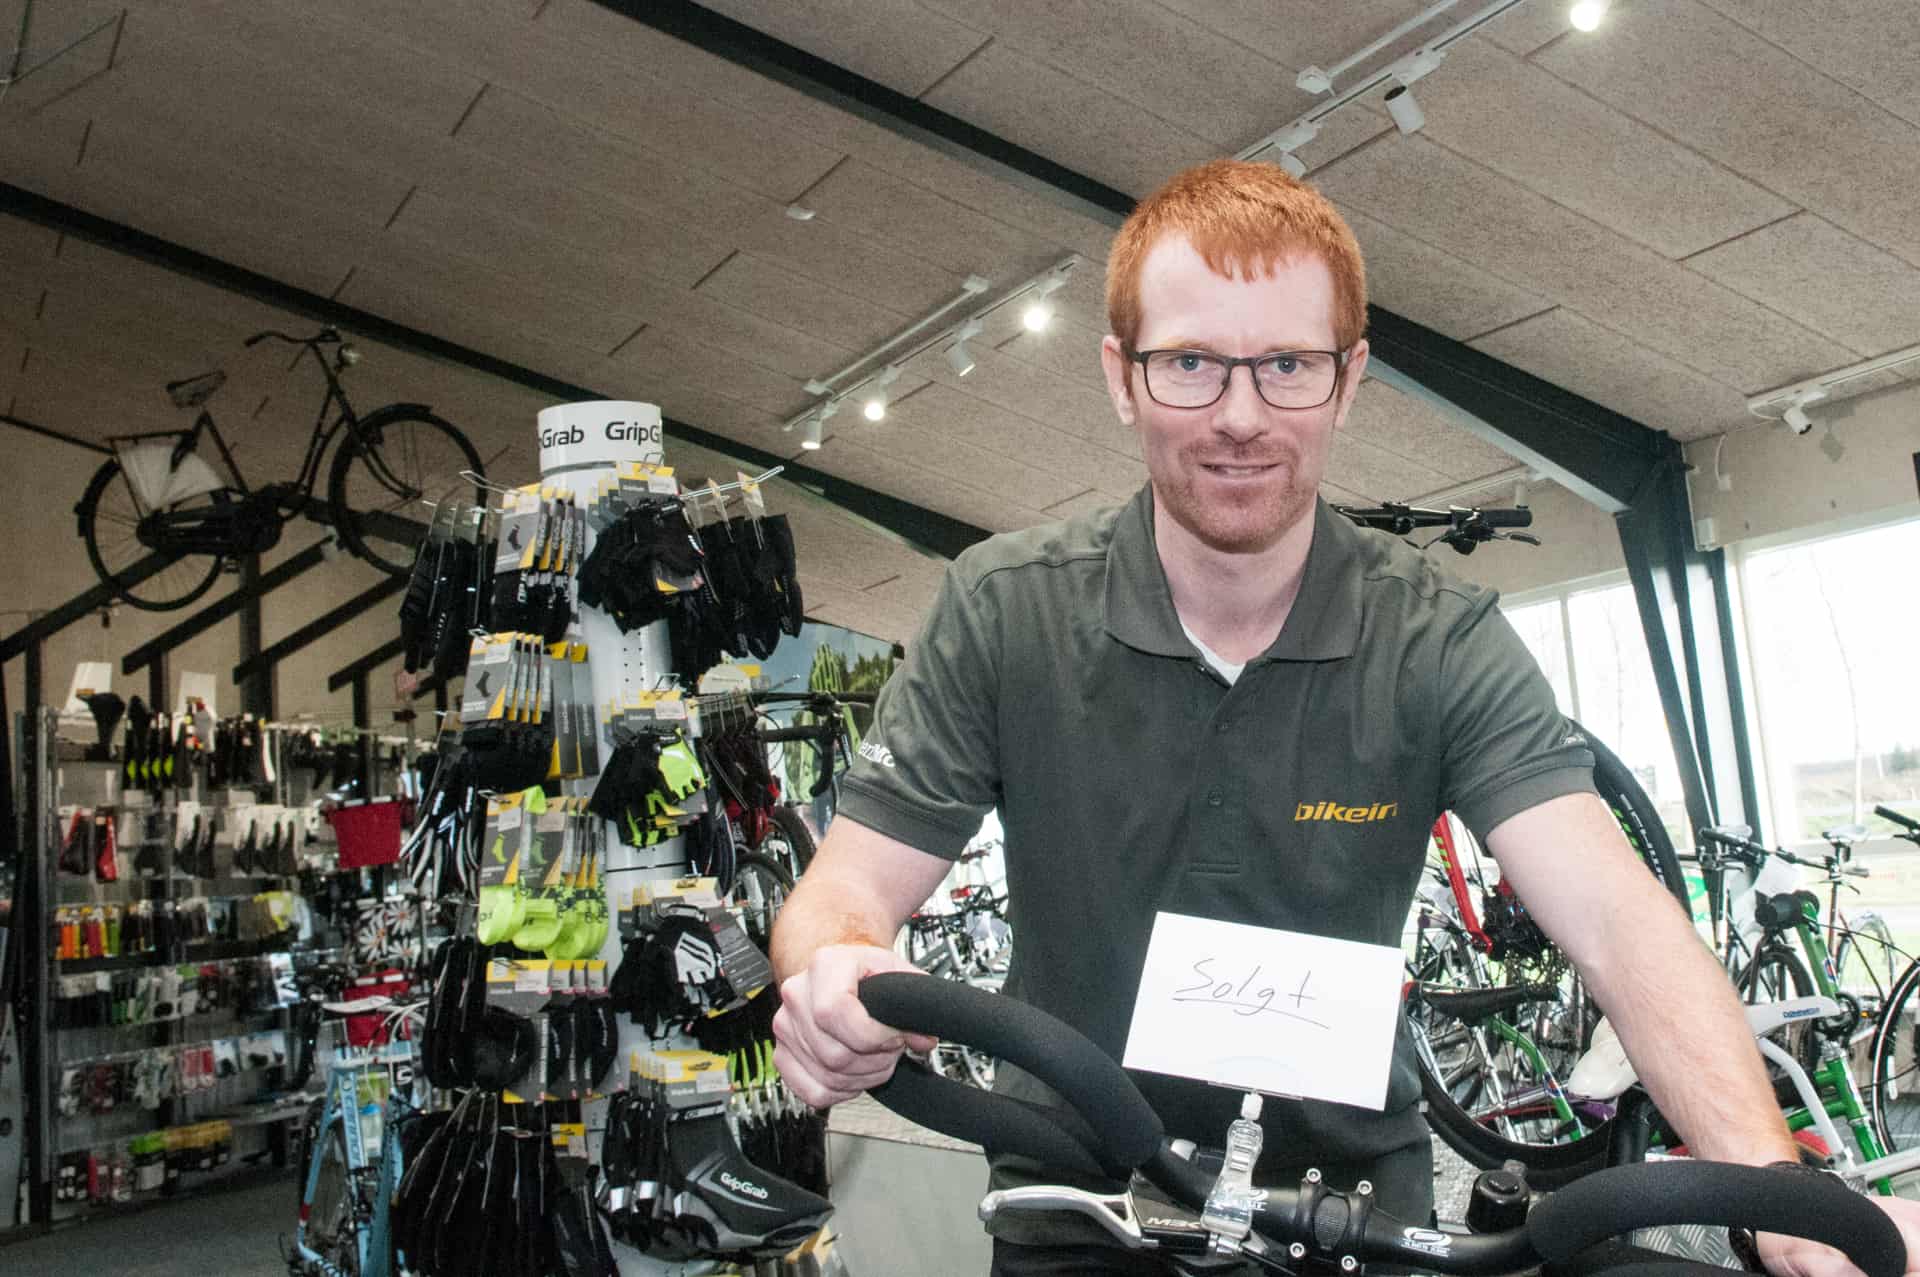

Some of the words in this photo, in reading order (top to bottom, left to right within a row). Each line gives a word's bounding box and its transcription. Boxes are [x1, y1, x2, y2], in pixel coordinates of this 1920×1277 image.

[539, 425, 584, 448] Grab
[1176, 958, 1317, 1016] Solgt
[721, 1172, 769, 1199] GripGrab
